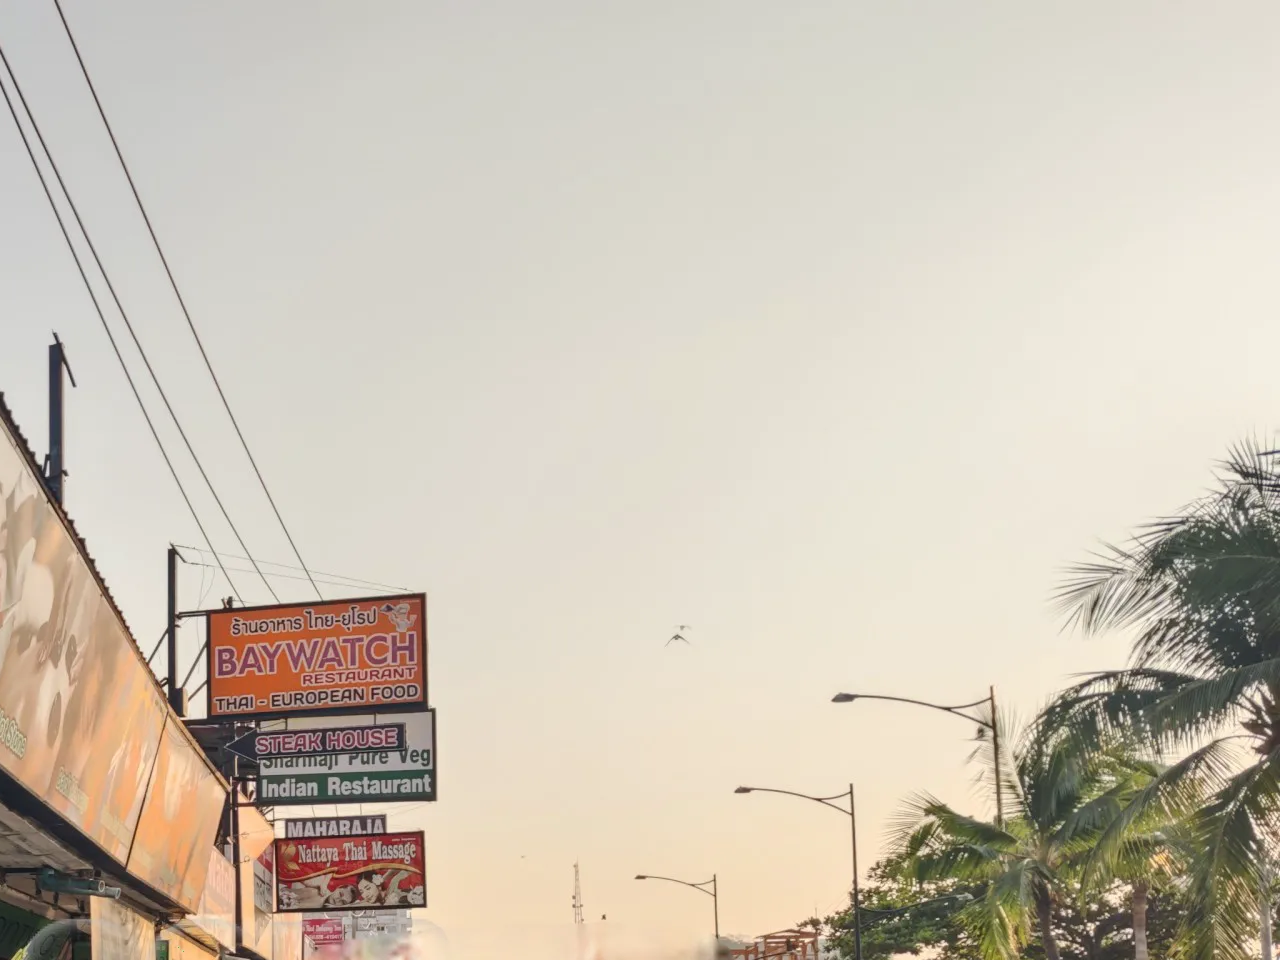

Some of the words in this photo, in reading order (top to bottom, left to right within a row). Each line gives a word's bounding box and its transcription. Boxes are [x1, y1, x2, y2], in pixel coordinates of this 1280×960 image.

[231, 616, 302, 637] ร้านอาหาร
[215, 632, 417, 678] BAYWATCH
[302, 667, 417, 686] RESTAURANT
[215, 696, 255, 712] THAI
[271, 688, 365, 708] EUROPEAN
[370, 684, 419, 699] FOOD
[256, 734, 322, 755] STEAK
[327, 727, 399, 750] HOUSE
[400, 745, 432, 767] Veg
[261, 775, 319, 798] Indian
[327, 772, 432, 796] Restaurant
[298, 844, 339, 867] Nattaya
[342, 842, 368, 860] Thai
[371, 839, 417, 864] Massage
